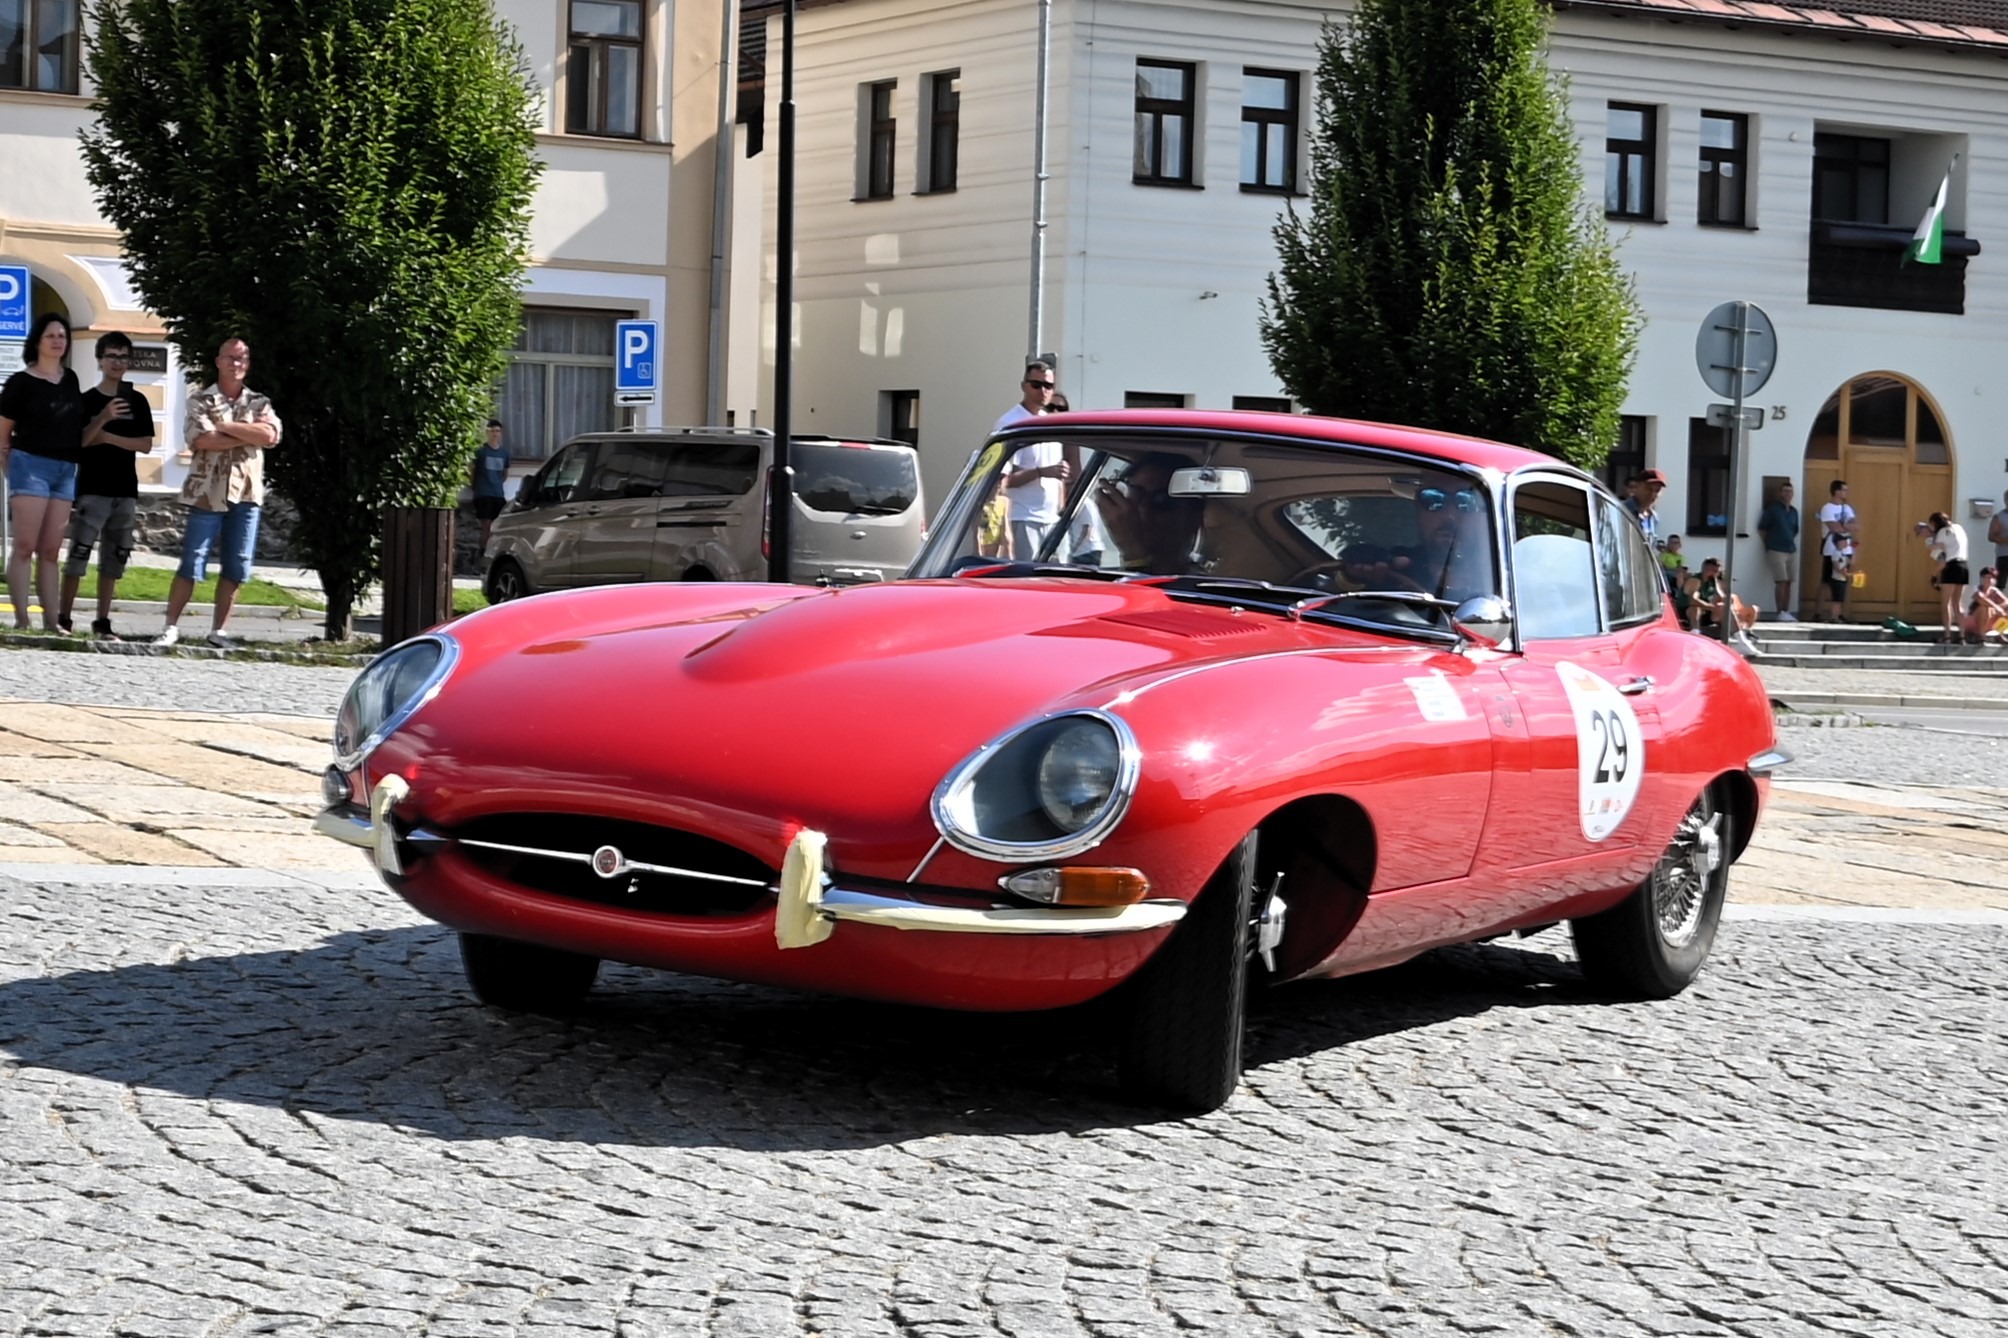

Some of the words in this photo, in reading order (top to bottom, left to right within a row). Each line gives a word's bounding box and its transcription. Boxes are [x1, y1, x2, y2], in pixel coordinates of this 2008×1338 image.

[624, 330, 649, 369] P
[1771, 405, 1787, 421] 25
[1591, 709, 1628, 784] 29
